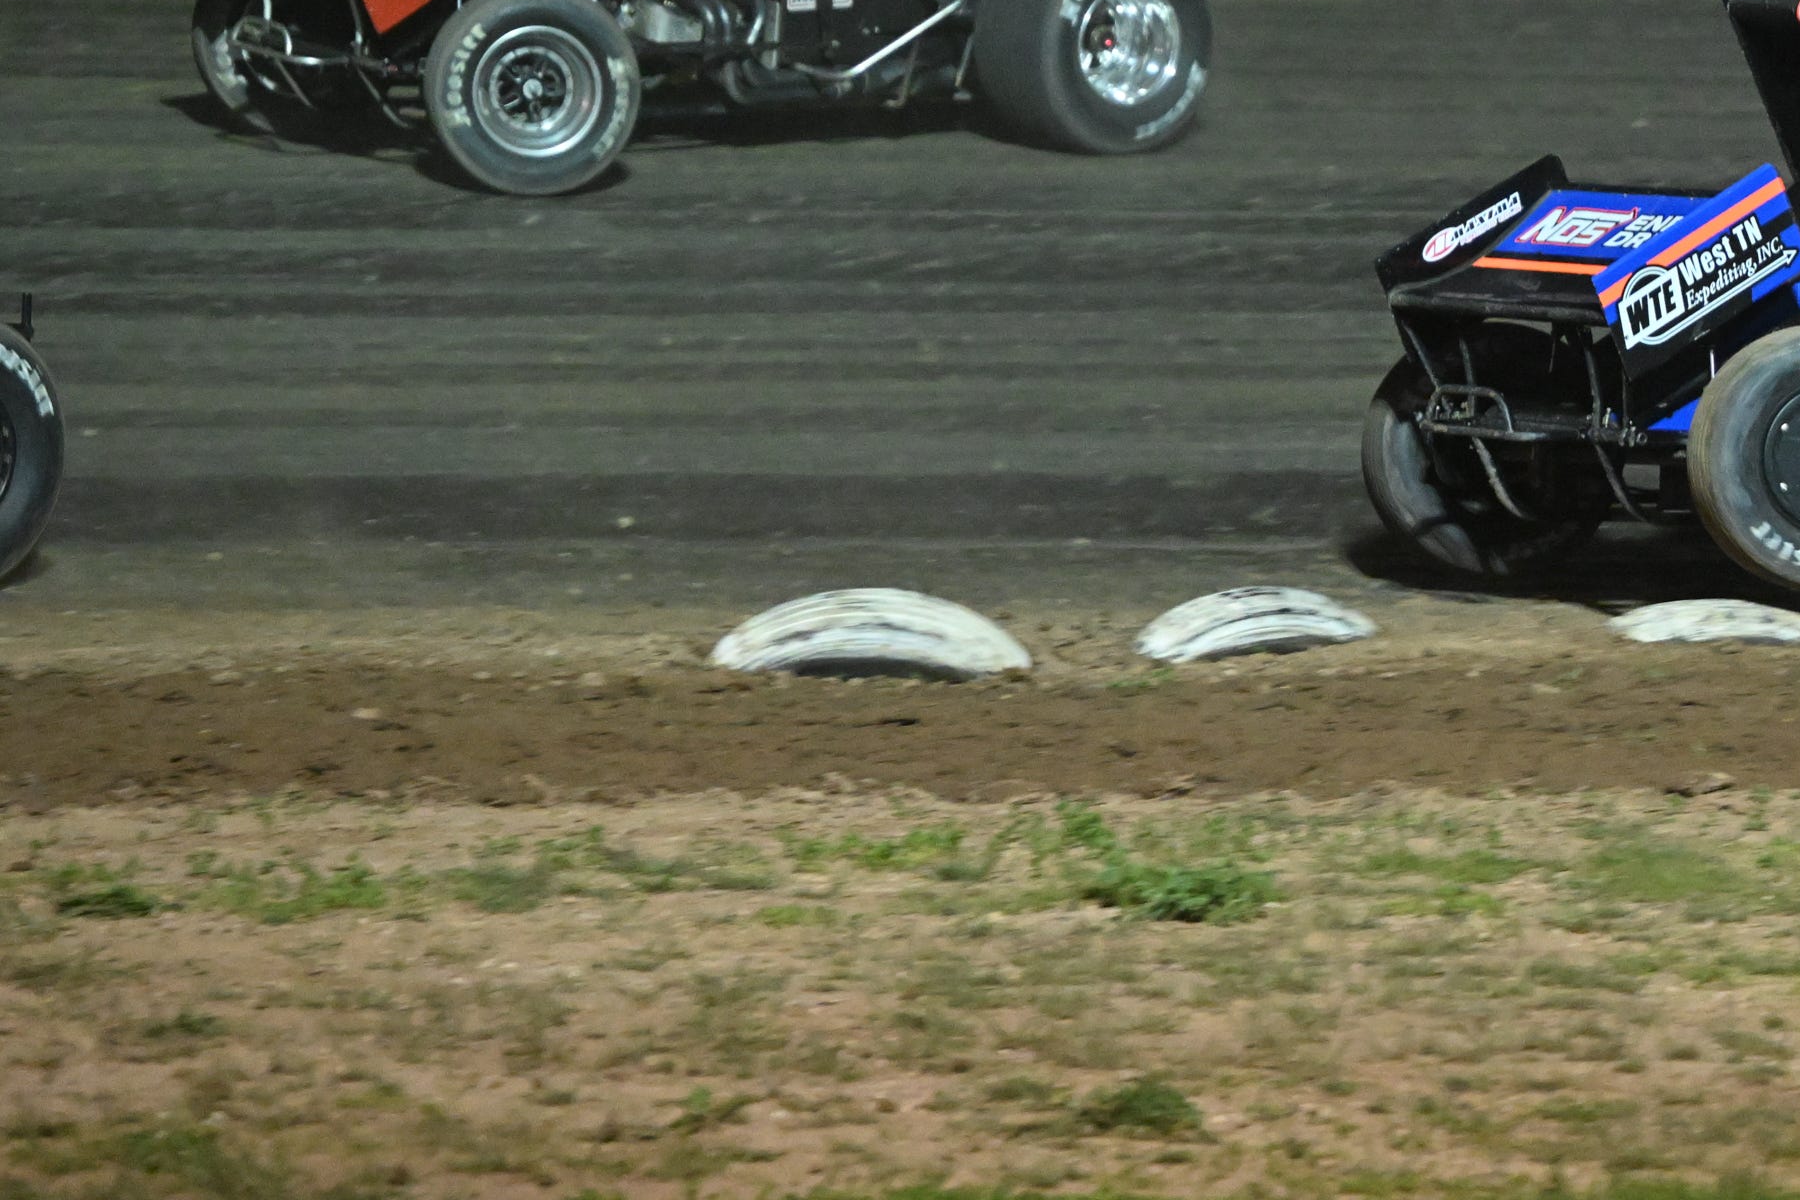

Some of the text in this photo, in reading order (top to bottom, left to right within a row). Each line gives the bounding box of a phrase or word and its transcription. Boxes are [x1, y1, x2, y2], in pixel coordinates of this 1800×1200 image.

[1513, 206, 1640, 247] NOS
[1679, 215, 1763, 287] West TN
[1686, 236, 1784, 310] Expediting, INC.
[1626, 278, 1676, 338] WTE
